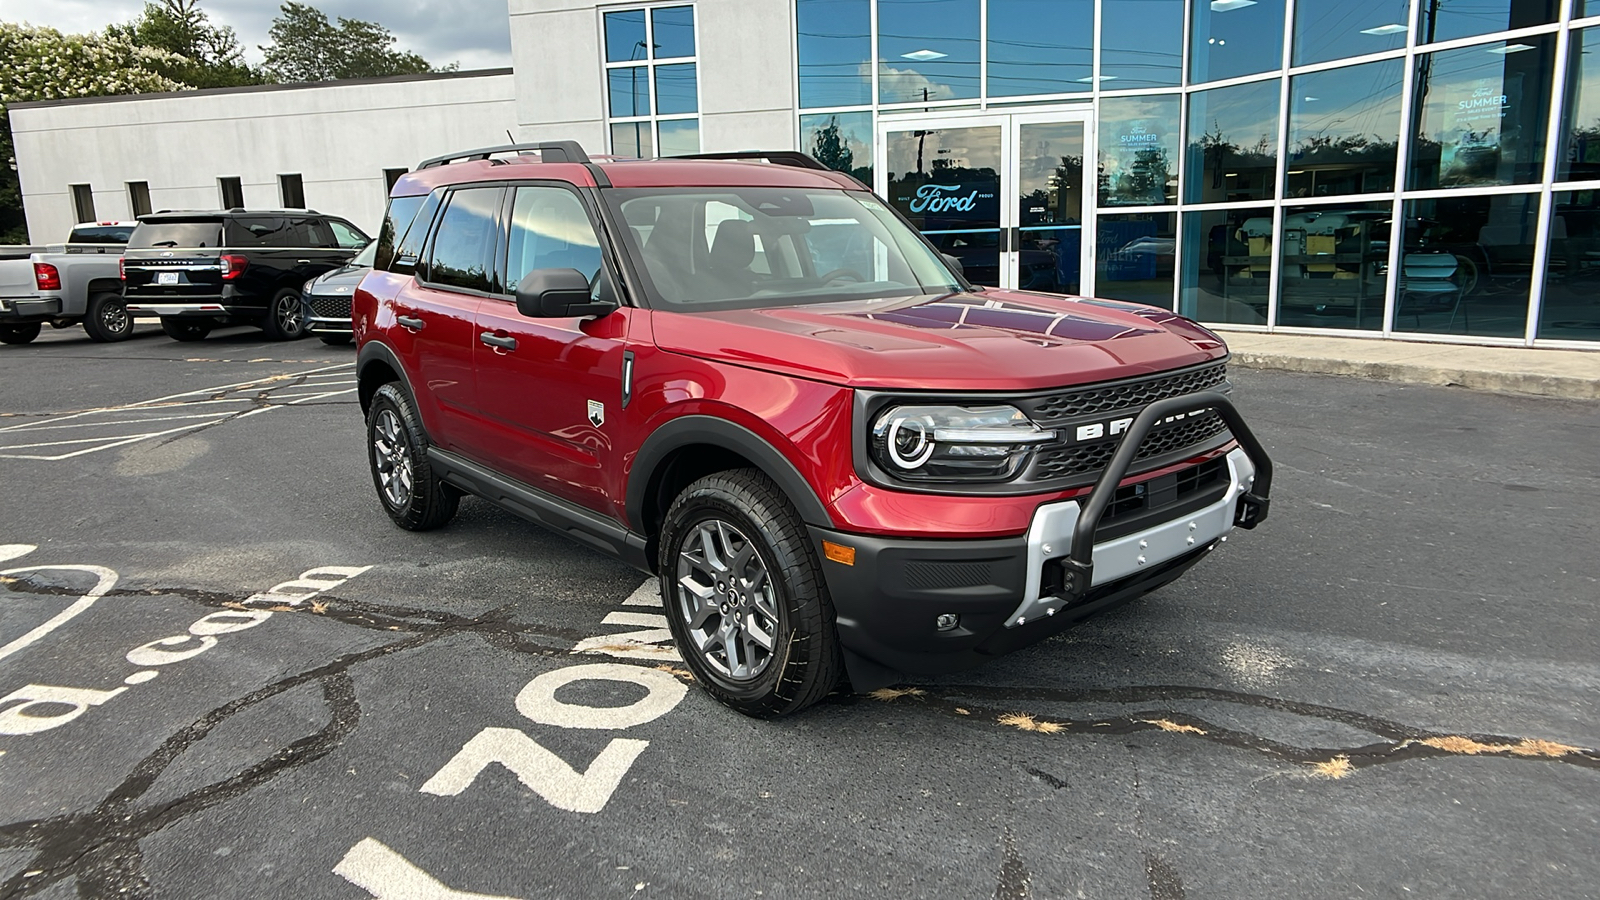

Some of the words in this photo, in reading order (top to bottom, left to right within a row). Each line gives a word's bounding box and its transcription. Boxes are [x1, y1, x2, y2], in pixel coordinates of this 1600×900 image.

[1472, 87, 1494, 98] Ford
[1458, 95, 1507, 110] SUMMER
[1130, 126, 1147, 134] Ford
[1120, 134, 1157, 143] SUMMER
[909, 184, 978, 213] Ford
[0, 565, 374, 736] a.com
[418, 576, 689, 814] ZON
